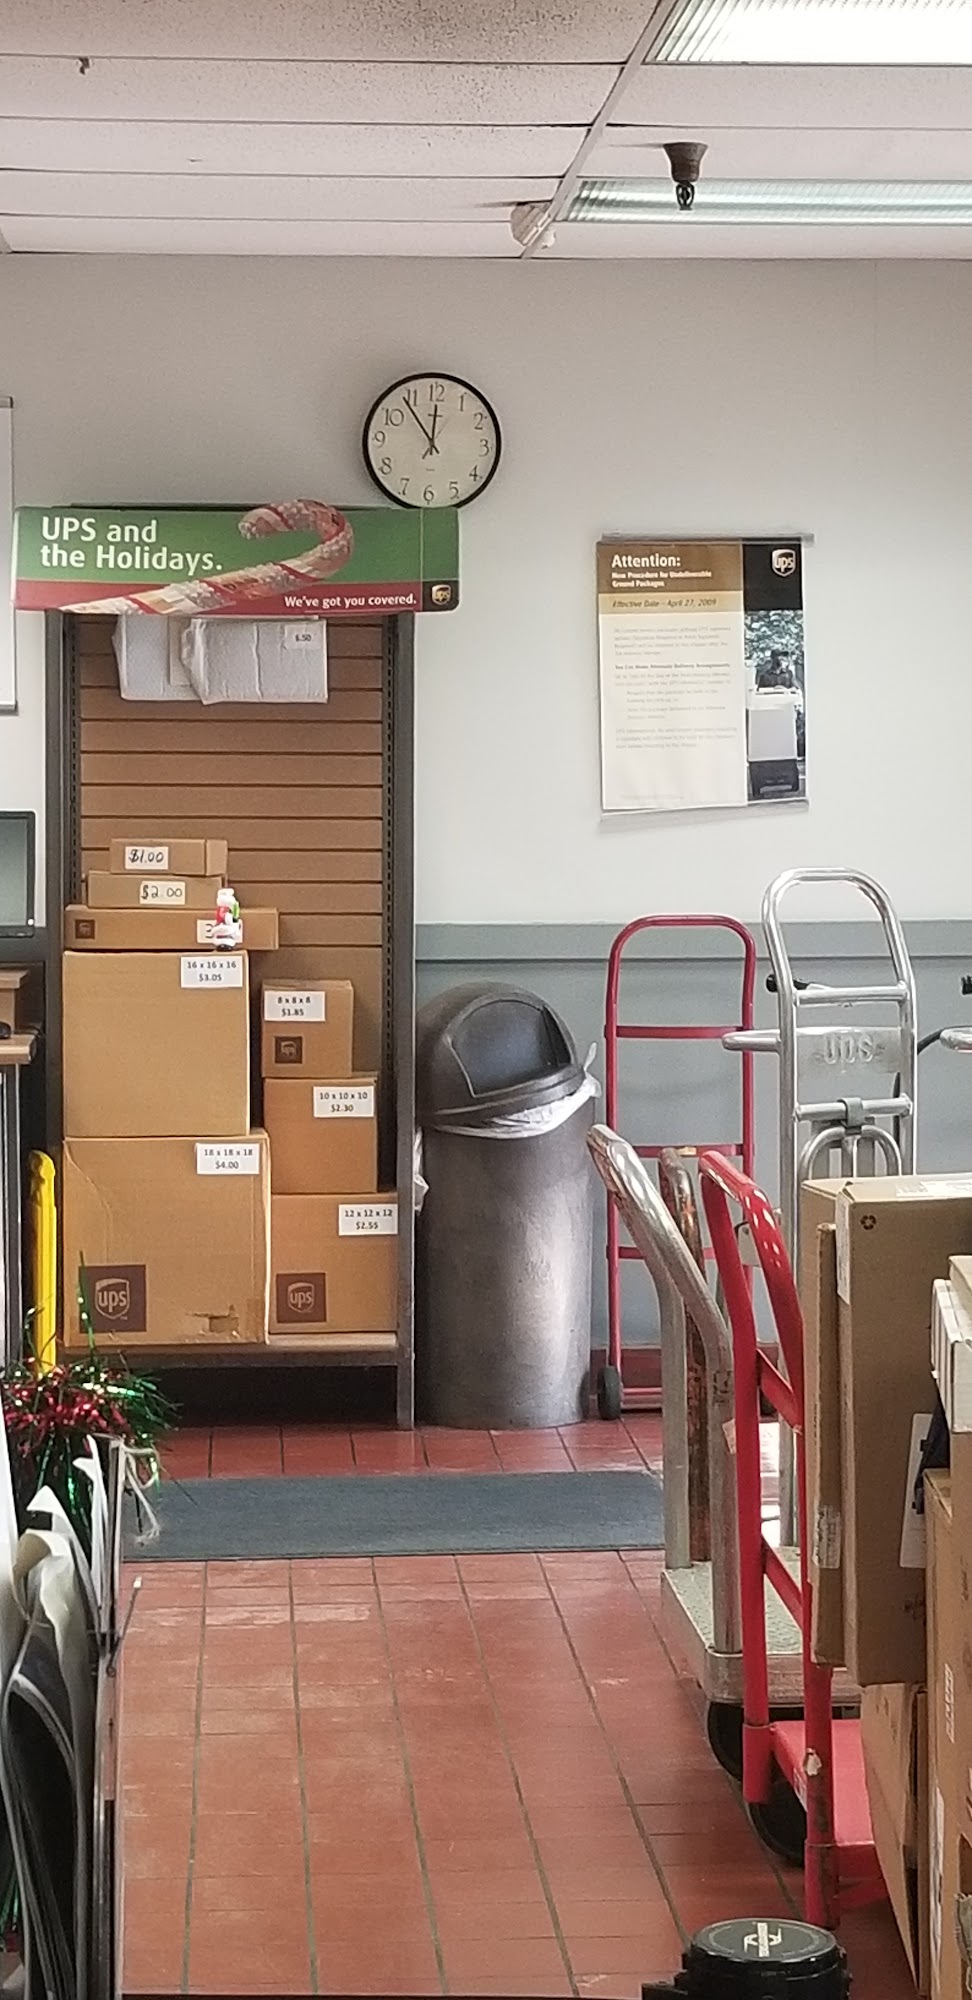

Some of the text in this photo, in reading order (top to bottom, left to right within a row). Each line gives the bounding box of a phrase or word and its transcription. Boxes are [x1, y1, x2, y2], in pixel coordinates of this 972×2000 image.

[429, 382, 445, 402] 12
[384, 408, 404, 426] 10
[473, 412, 484, 430] 2
[374, 431, 386, 448] 9
[479, 438, 489, 457] 3
[379, 457, 392, 475] 8
[469, 465, 480, 482] 4
[399, 478, 410, 495] 7
[423, 485, 434, 504] 6
[449, 481, 460, 499] 5
[42, 516, 157, 543] UPS and
[40, 543, 223, 576] the Holidays.
[611, 553, 681, 568] Attention:
[774, 556, 794, 572] ups
[611, 580, 665, 588] Ground Packages
[284, 593, 417, 609] We've got you covered.
[643, 600, 660, 608] Date
[667, 598, 682, 608] April
[128, 848, 165, 864] $1.00
[140, 884, 183, 900] $2.00
[187, 961, 197, 969] 16
[207, 961, 217, 969] 16
[226, 961, 237, 969] 16
[199, 973, 222, 982] $3.05
[320, 1092, 329, 1100] 10
[339, 1092, 349, 1100] 10
[331, 1104, 354, 1112] $2.30
[215, 1161, 239, 1170] $4.00
[383, 1209, 393, 1217] 12
[356, 1221, 379, 1230] $2.55
[98, 1290, 127, 1312] ups
[289, 1292, 313, 1307] ups
